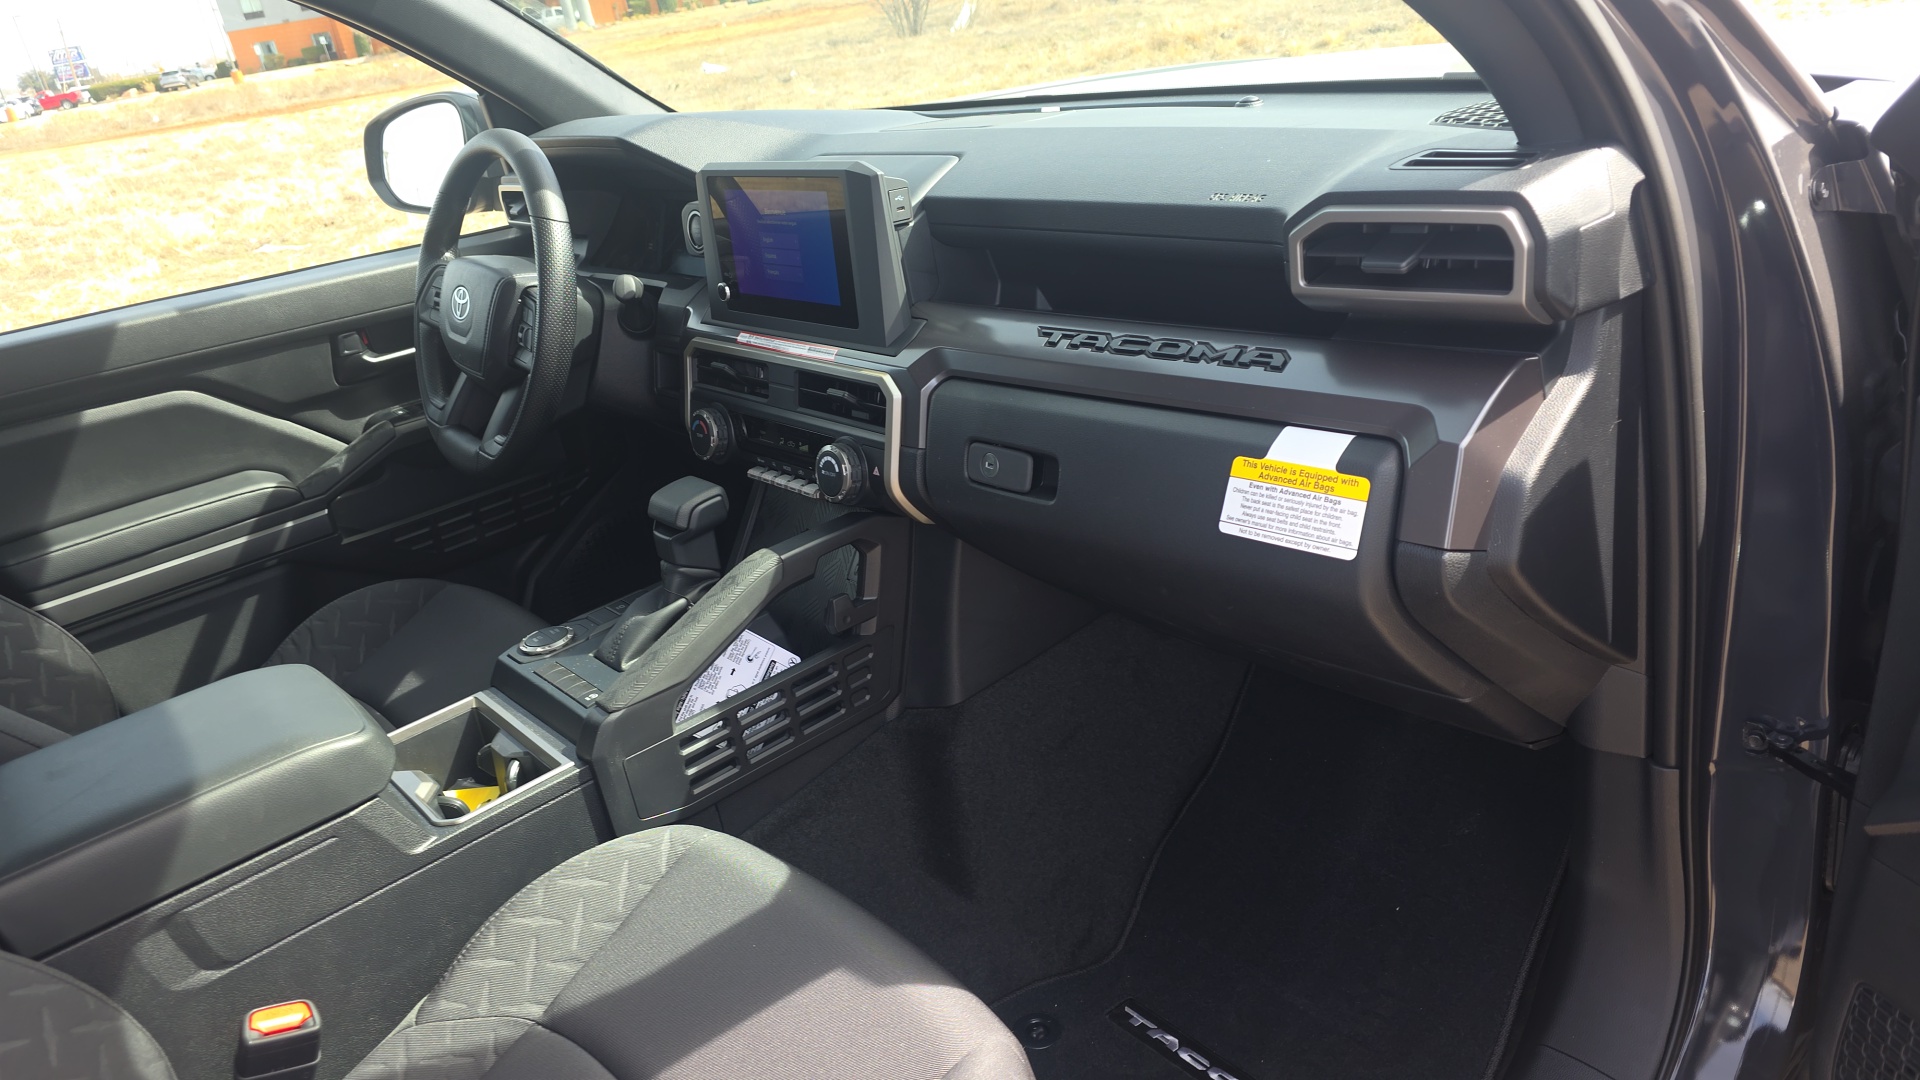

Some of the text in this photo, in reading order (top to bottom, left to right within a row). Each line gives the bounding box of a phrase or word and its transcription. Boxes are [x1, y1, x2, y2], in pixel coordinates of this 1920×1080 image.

[1037, 326, 1292, 373] TACOMA
[1242, 459, 1359, 486] This Vehicle is Equipped with
[1258, 471, 1335, 494] Advanced Air Bags
[1248, 482, 1263, 490] Even
[1264, 485, 1278, 493] with
[1278, 487, 1311, 499] Advanced
[1323, 496, 1341, 506] Bags
